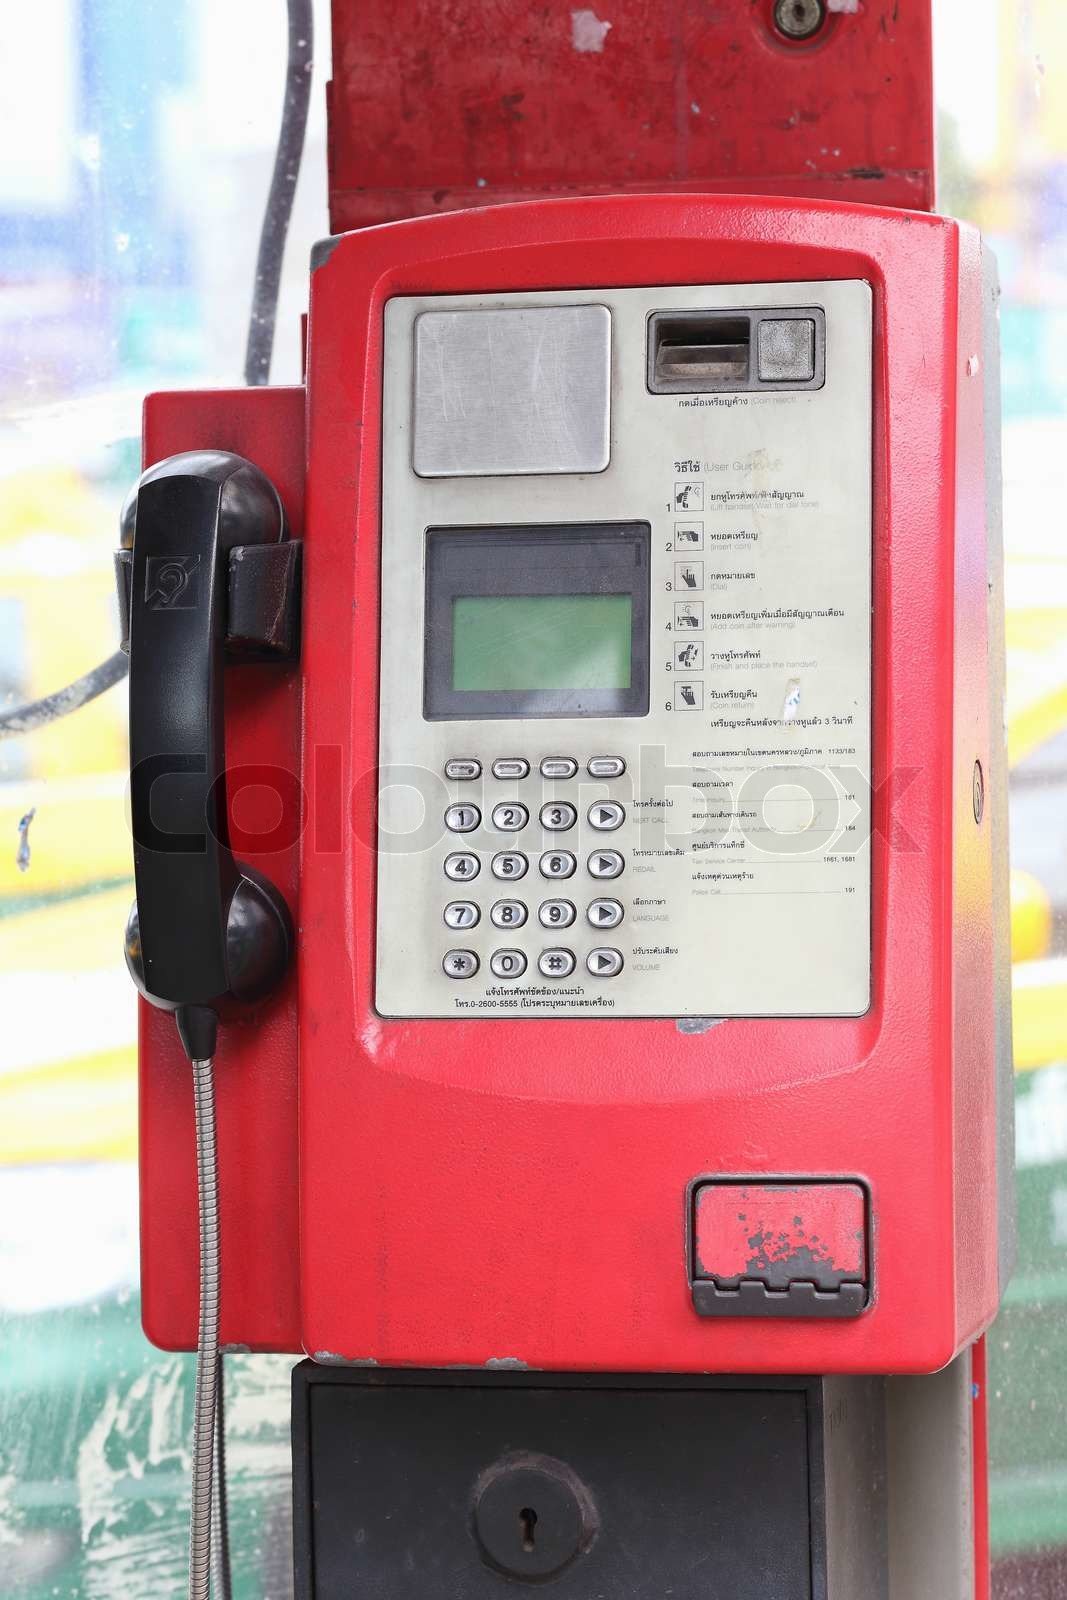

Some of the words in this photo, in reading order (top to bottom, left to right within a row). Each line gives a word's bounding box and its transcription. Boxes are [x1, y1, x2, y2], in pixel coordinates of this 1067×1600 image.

[674, 460, 700, 473] วิธีใช้
[665, 504, 671, 513] 1
[665, 543, 672, 552] 2
[710, 531, 758, 541] หยอดเหรียญ
[665, 582, 672, 591] 3
[710, 571, 756, 580] กดหมายเลข
[665, 622, 672, 632] 4
[665, 662, 672, 671] 5
[710, 650, 761, 663] วางหูโทรศัพท์
[665, 702, 672, 711] 6
[710, 690, 758, 701] รับเหรียญคืน
[825, 717, 830, 726] 3
[832, 716, 853, 726] วินาที
[486, 986, 585, 997] แจ้งโทรศัพท์ขัดข้อง/แนะนำ
[455, 998, 518, 1008] โทร.0-2600-5555
[520, 996, 615, 1010] (โปรดระบุหมายเลขเครื่อง)
